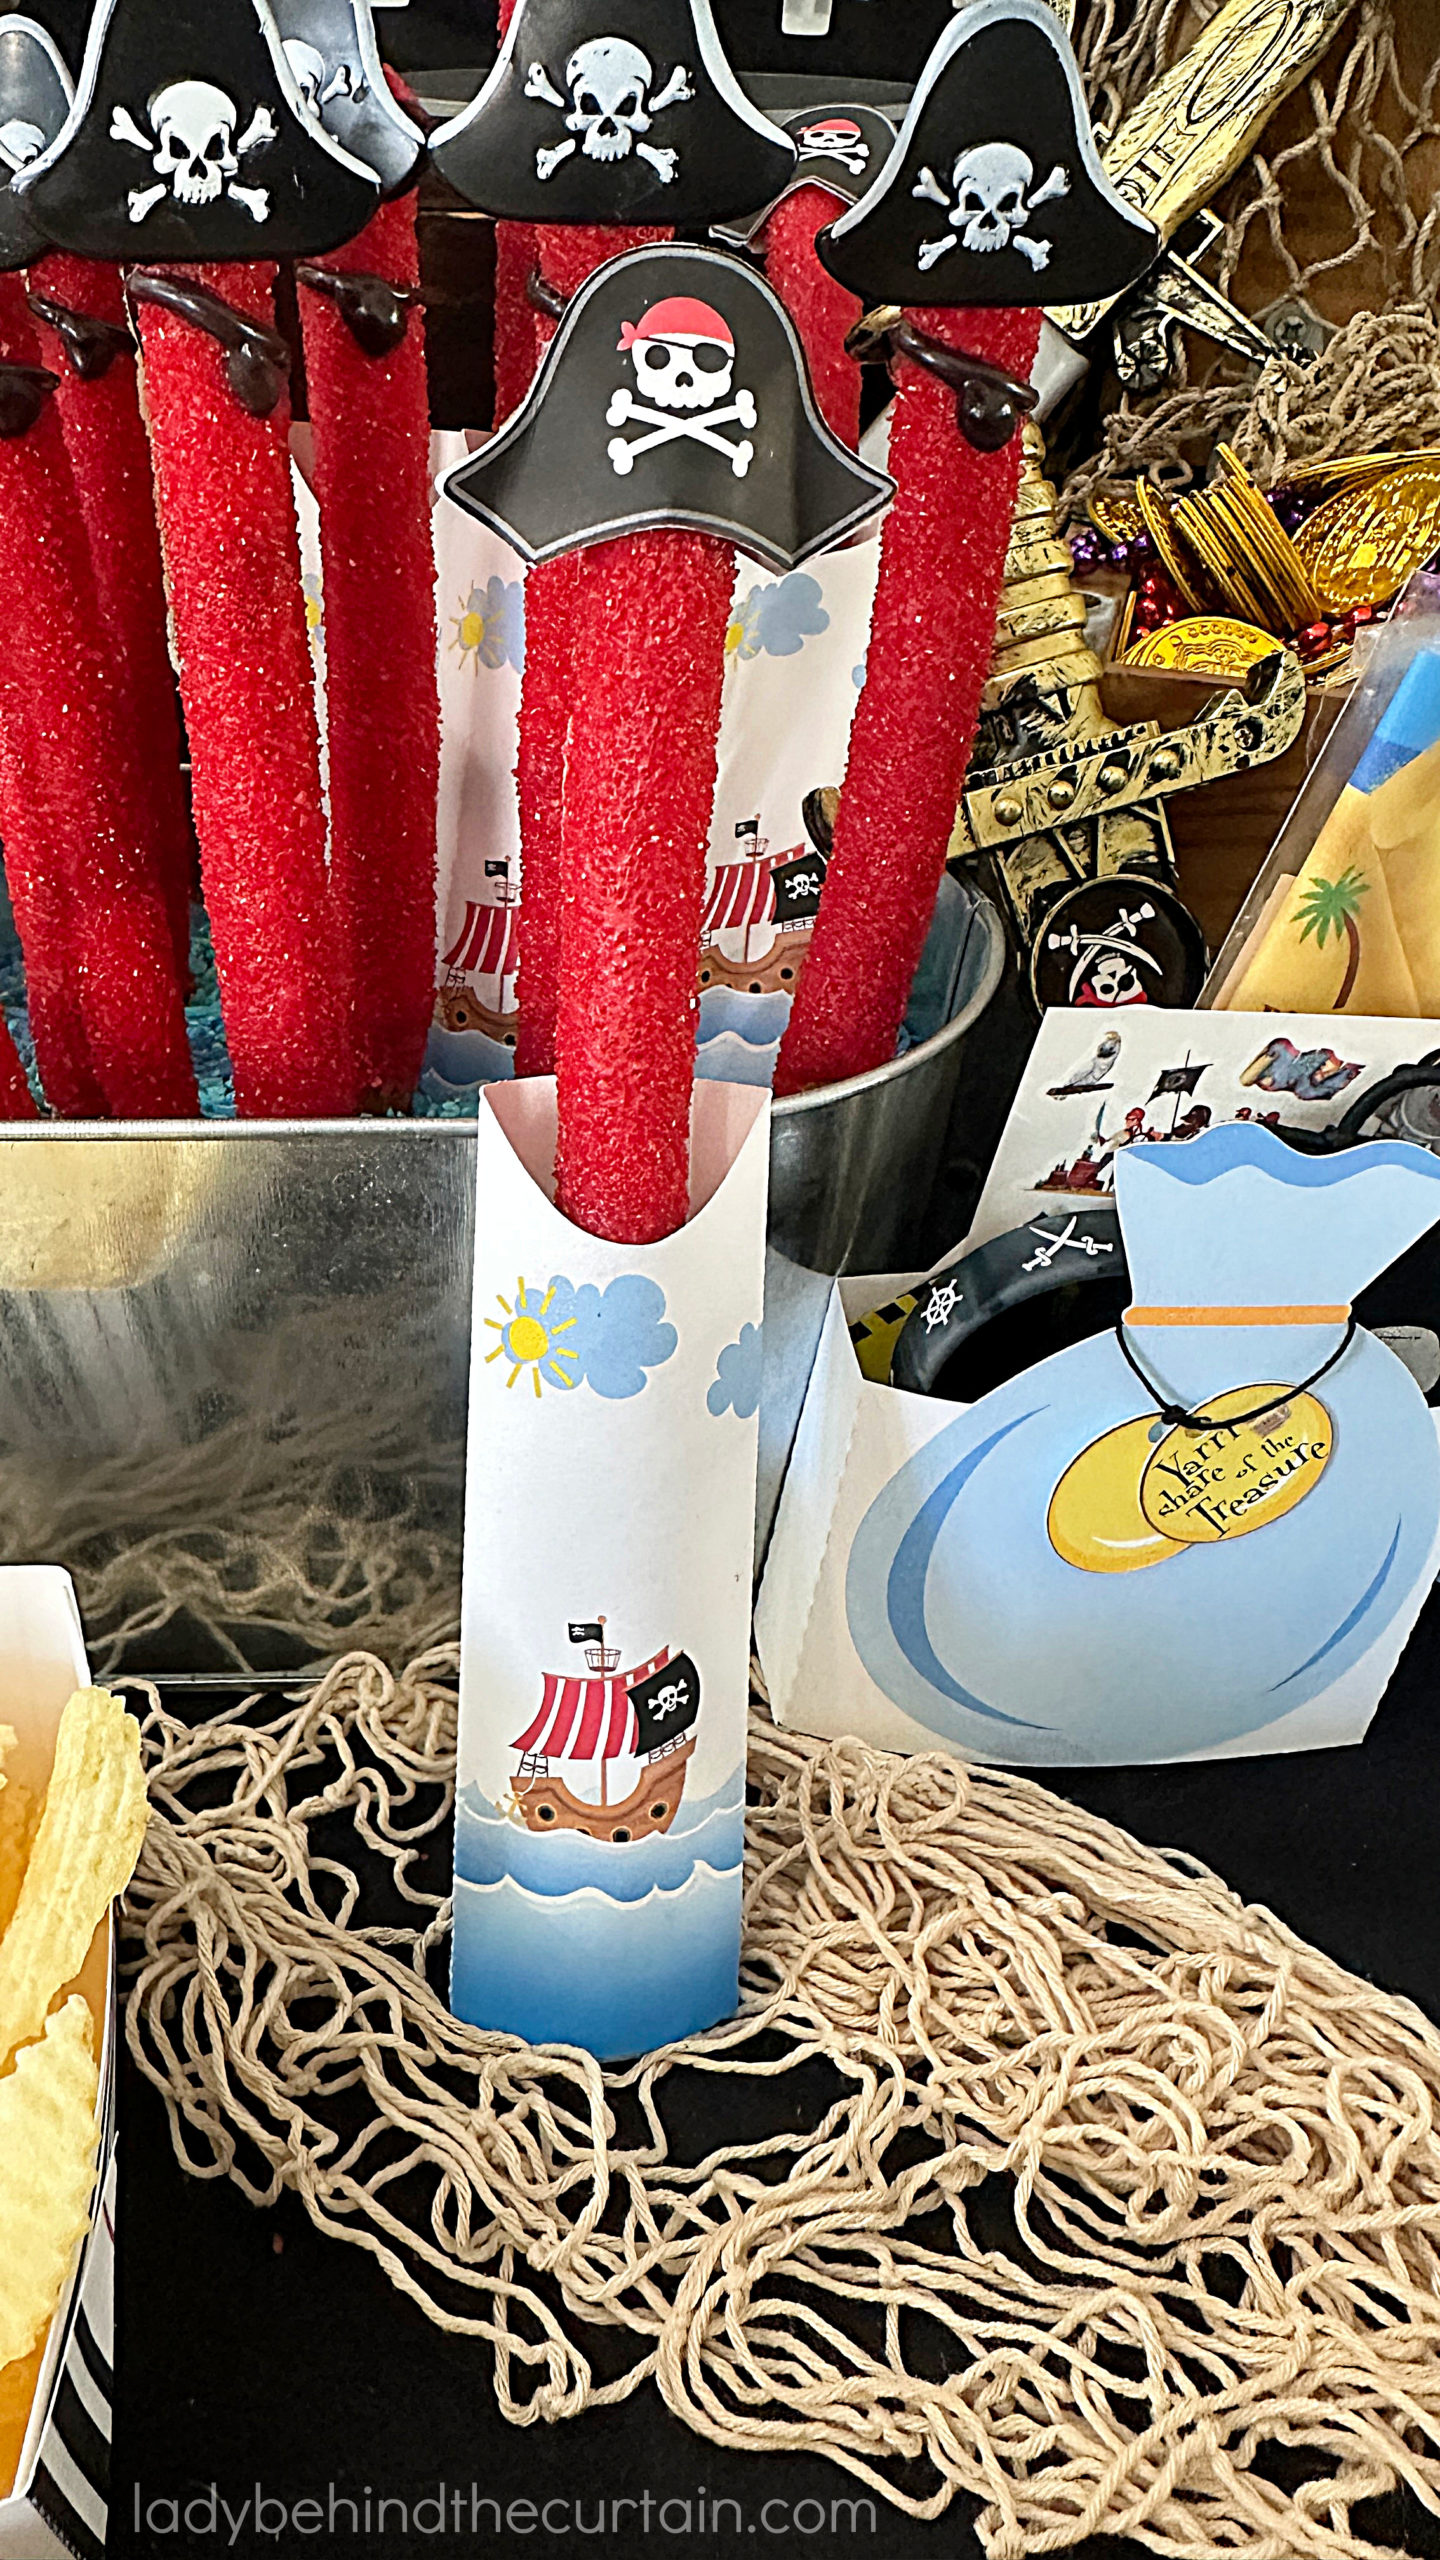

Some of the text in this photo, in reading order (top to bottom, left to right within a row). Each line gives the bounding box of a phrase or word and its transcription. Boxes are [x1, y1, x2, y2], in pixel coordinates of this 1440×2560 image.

[1158, 1436, 1295, 1518] share of the
[1185, 1442, 1329, 1539] Treasure
